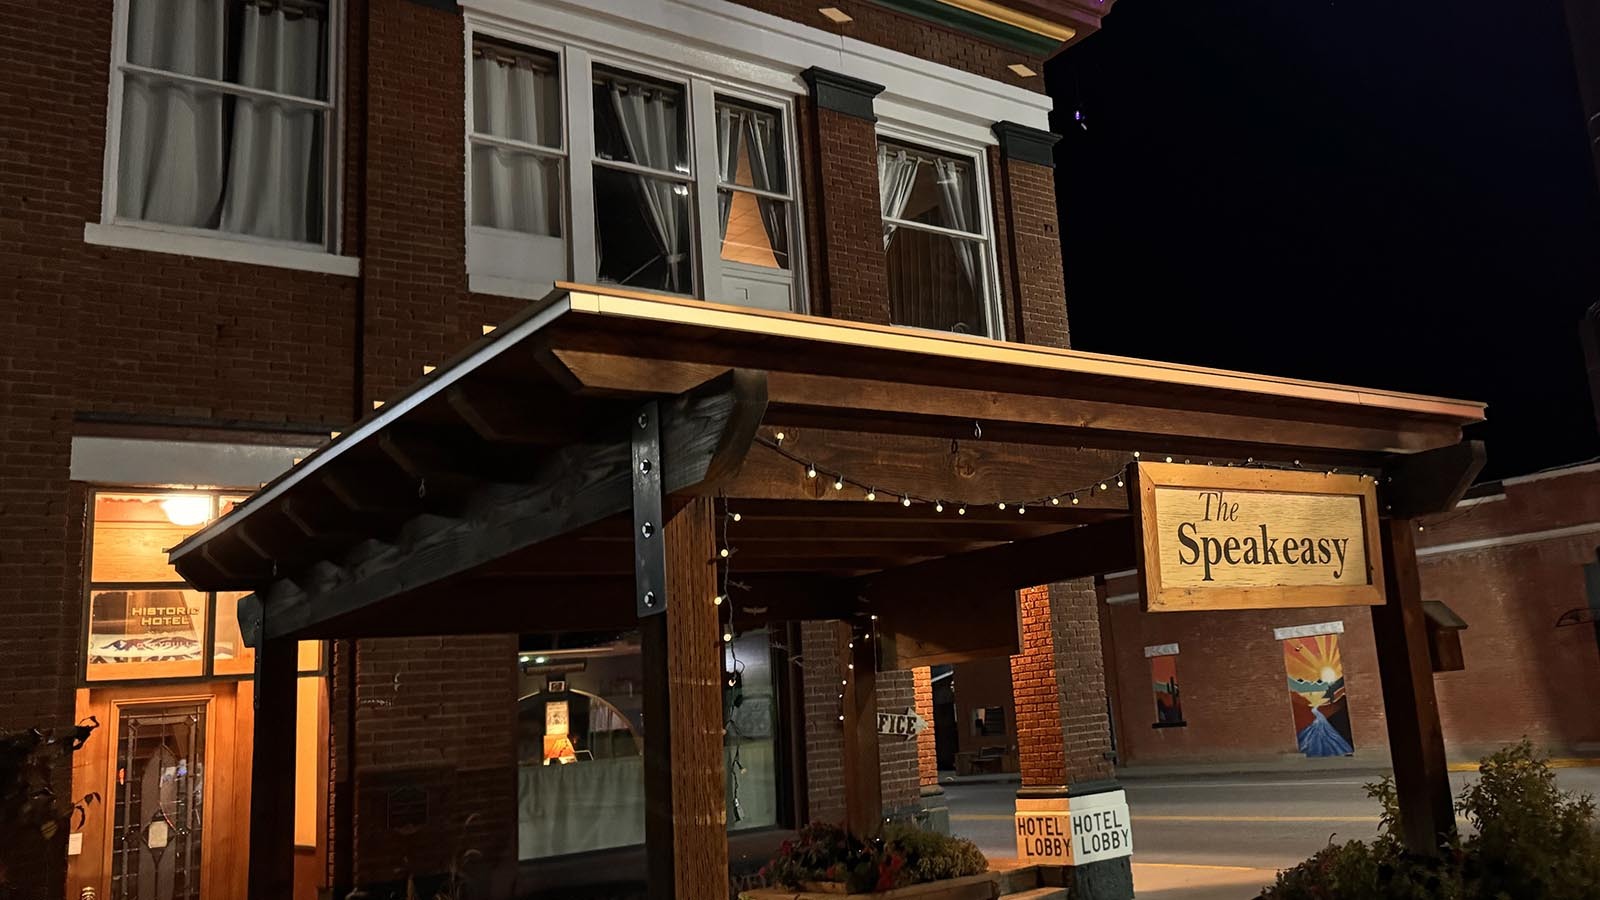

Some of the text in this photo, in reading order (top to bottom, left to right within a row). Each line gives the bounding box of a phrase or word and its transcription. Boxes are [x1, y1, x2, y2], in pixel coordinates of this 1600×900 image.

[1199, 491, 1239, 522] The
[1177, 522, 1349, 581] Speakeasy
[131, 607, 200, 616] HISTORIC
[141, 616, 190, 626] HOTEL
[877, 714, 917, 734] FICE
[1018, 817, 1063, 836] HOTEL
[1073, 810, 1122, 835] HOTEL
[1025, 838, 1071, 856] LOBBY
[1081, 829, 1129, 855] LOBBY
